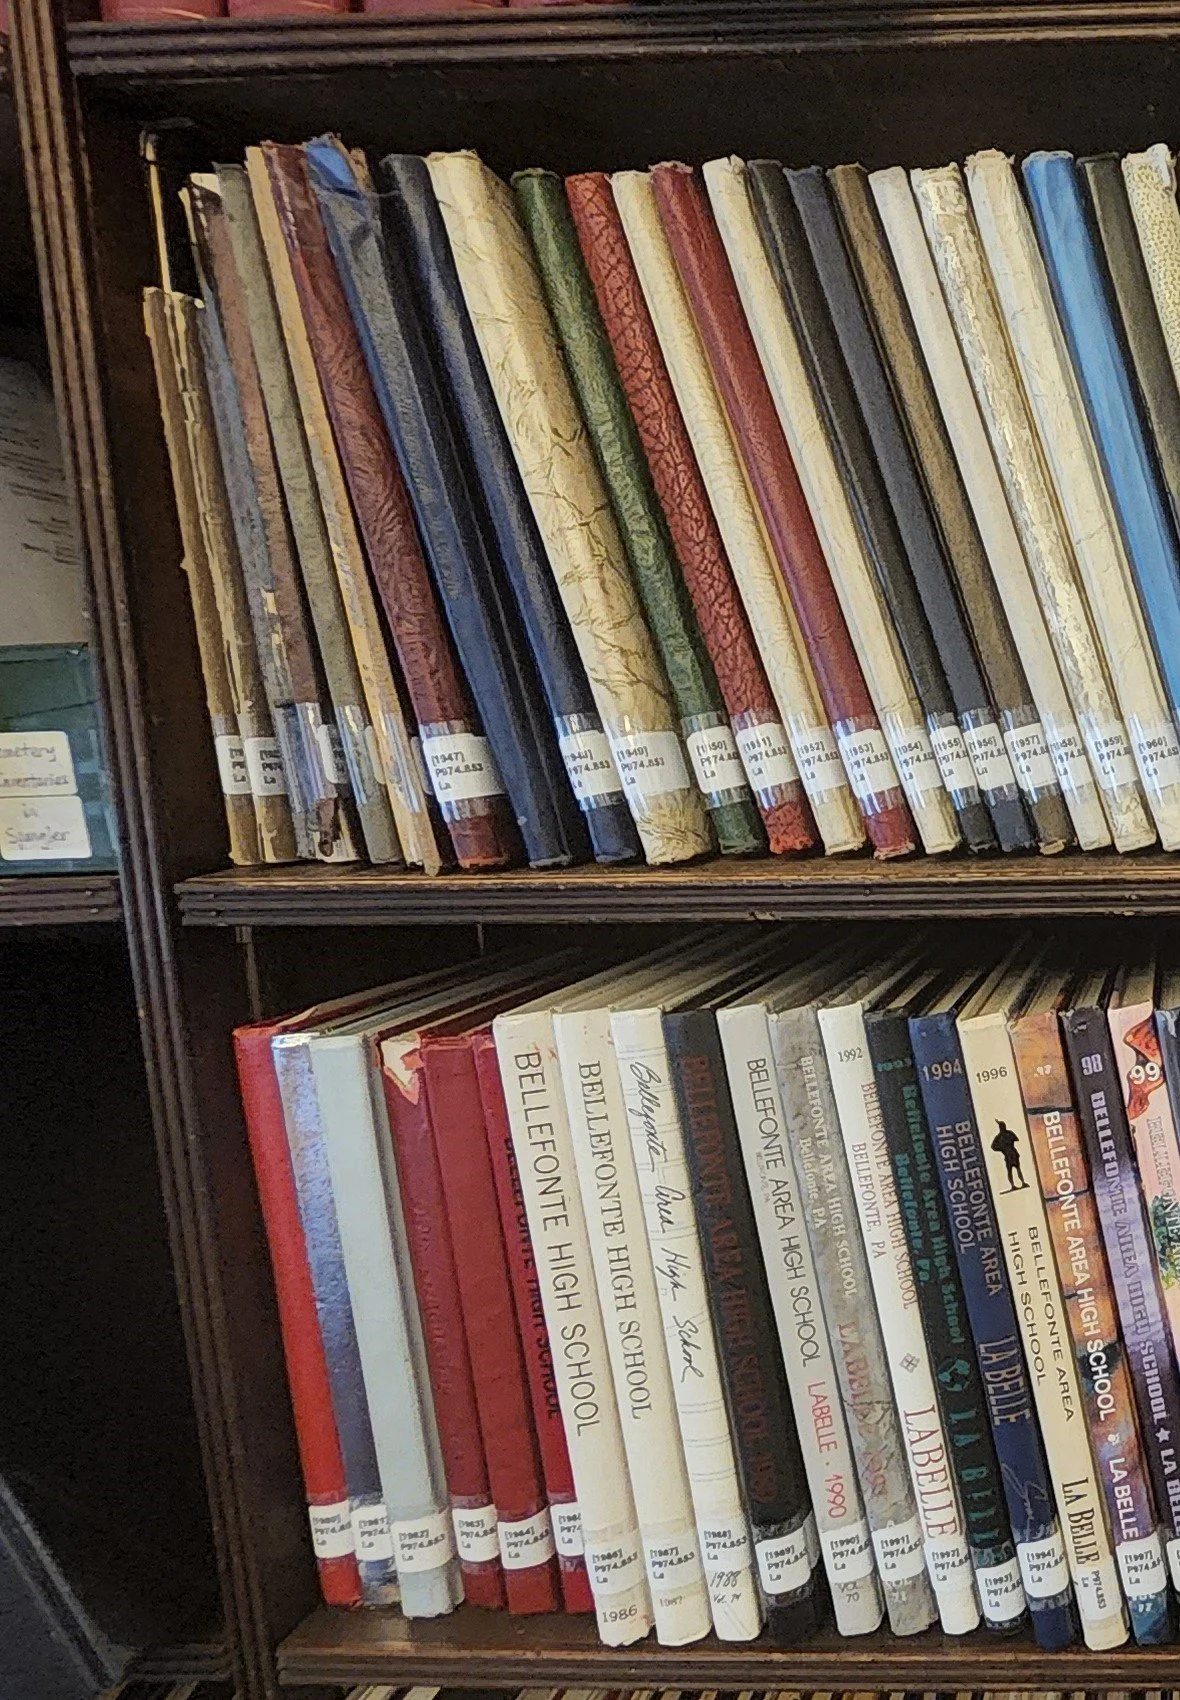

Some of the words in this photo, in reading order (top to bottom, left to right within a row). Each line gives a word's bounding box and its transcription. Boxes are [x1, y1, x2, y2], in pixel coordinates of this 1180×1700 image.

[431, 751, 466, 767] [1947]
[838, 1048, 863, 1062] 1992
[922, 1059, 963, 1082] 1994
[976, 1066, 1009, 1085] 1996
[1081, 1053, 1103, 1076] 98
[1130, 1062, 1161, 1085] 99
[514, 1051, 569, 1231] BELLEFONTE
[746, 1058, 786, 1170] BELLEFONTE
[861, 1081, 892, 1169] BELLEFONTE
[578, 1060, 625, 1237] BELLEFONTE
[1043, 1110, 1082, 1233] BELLEFONTE
[768, 1178, 795, 1231] AREA
[852, 1142, 881, 1232] BELLEFONTE,
[871, 1240, 886, 1258] PA
[878, 1174, 897, 1208] AREA
[934, 1125, 960, 1173] HIGH
[948, 1177, 975, 1254] SCHOOL
[954, 1120, 994, 1242] BELLEFONTE
[981, 1246, 1004, 1297] AREA
[780, 1234, 805, 1282] HIGH
[886, 1211, 910, 1248] HIGH
[1067, 1236, 1091, 1286] AREA
[547, 1242, 582, 1312] HIGH
[607, 1244, 637, 1312] HIGH
[895, 1252, 917, 1309] SCHOOL
[1091, 1090, 1127, 1217] BELLEFONTE
[1139, 1339, 1168, 1425] SCHOOL
[1160, 1449, 1178, 1475] LA
[789, 1285, 820, 1368] SCHOOL
[1007, 1232, 1028, 1287] HIGH
[1019, 1292, 1049, 1387] SCHOOL
[1027, 1225, 1064, 1361] BELLEFONTE
[1056, 1366, 1075, 1422] AREA
[1077, 1287, 1101, 1336] HIGH
[560, 1323, 600, 1437] SCHOOL
[618, 1320, 652, 1420] SCHOOL
[1087, 1338, 1117, 1422] SCHOOL
[807, 1380, 838, 1453] LABELLE
[825, 1474, 847, 1519] 1990
[904, 1405, 959, 1538] LABELLE
[1061, 1477, 1089, 1506] LA
[1068, 1507, 1100, 1565] BELLE
[1113, 1484, 1140, 1540] BELLE
[710, 1571, 742, 1588] 1988
[602, 1604, 637, 1623] 1986
